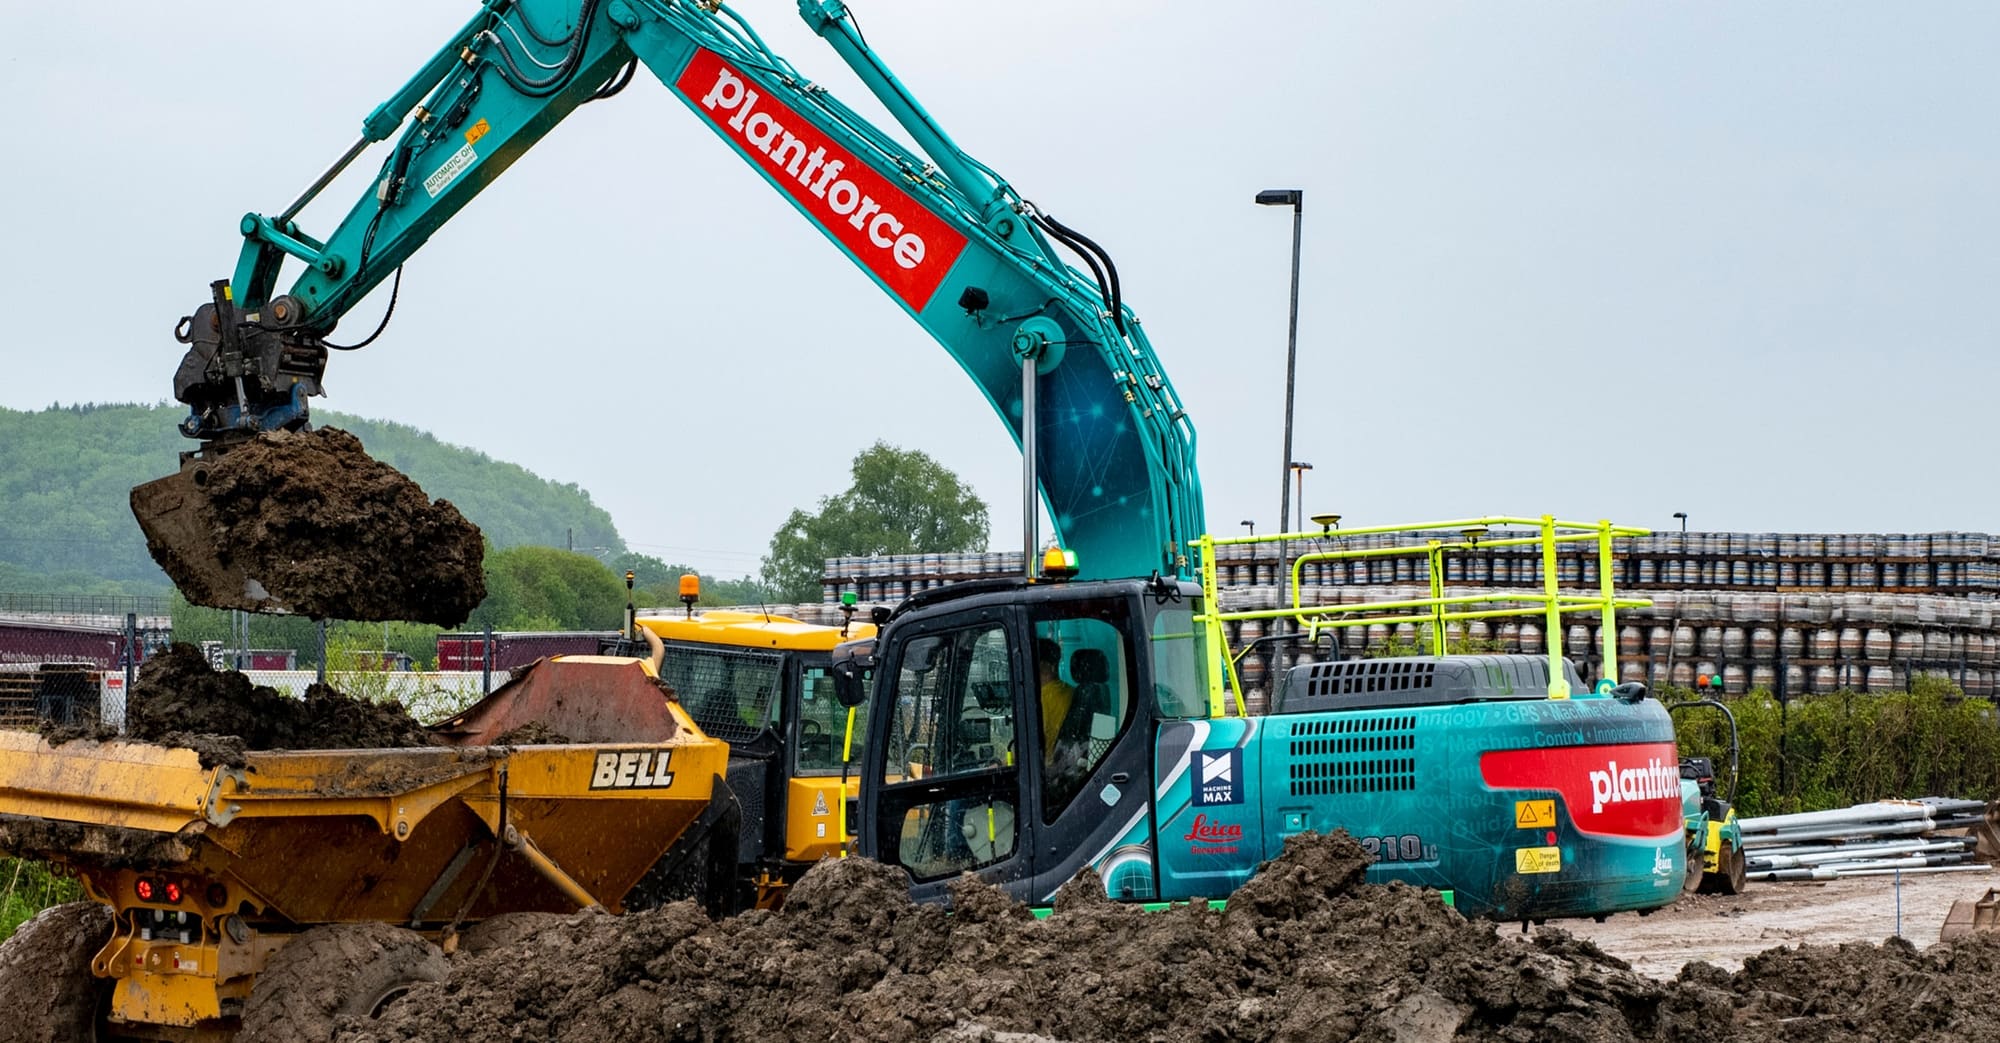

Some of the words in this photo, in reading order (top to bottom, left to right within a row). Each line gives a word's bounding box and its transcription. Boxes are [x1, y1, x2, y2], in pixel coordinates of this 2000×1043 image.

[426, 155, 462, 189] AUTOMATIC
[702, 68, 926, 270] plantforce
[1505, 703, 1540, 723] GPS
[1534, 727, 1585, 748] Control
[1592, 723, 1644, 743] Innovation
[588, 748, 676, 791] BELL
[1203, 792, 1233, 803] MAX
[1589, 758, 1681, 814] plantforc
[1184, 813, 1244, 843] Leica
[1424, 843, 1439, 861] LC
